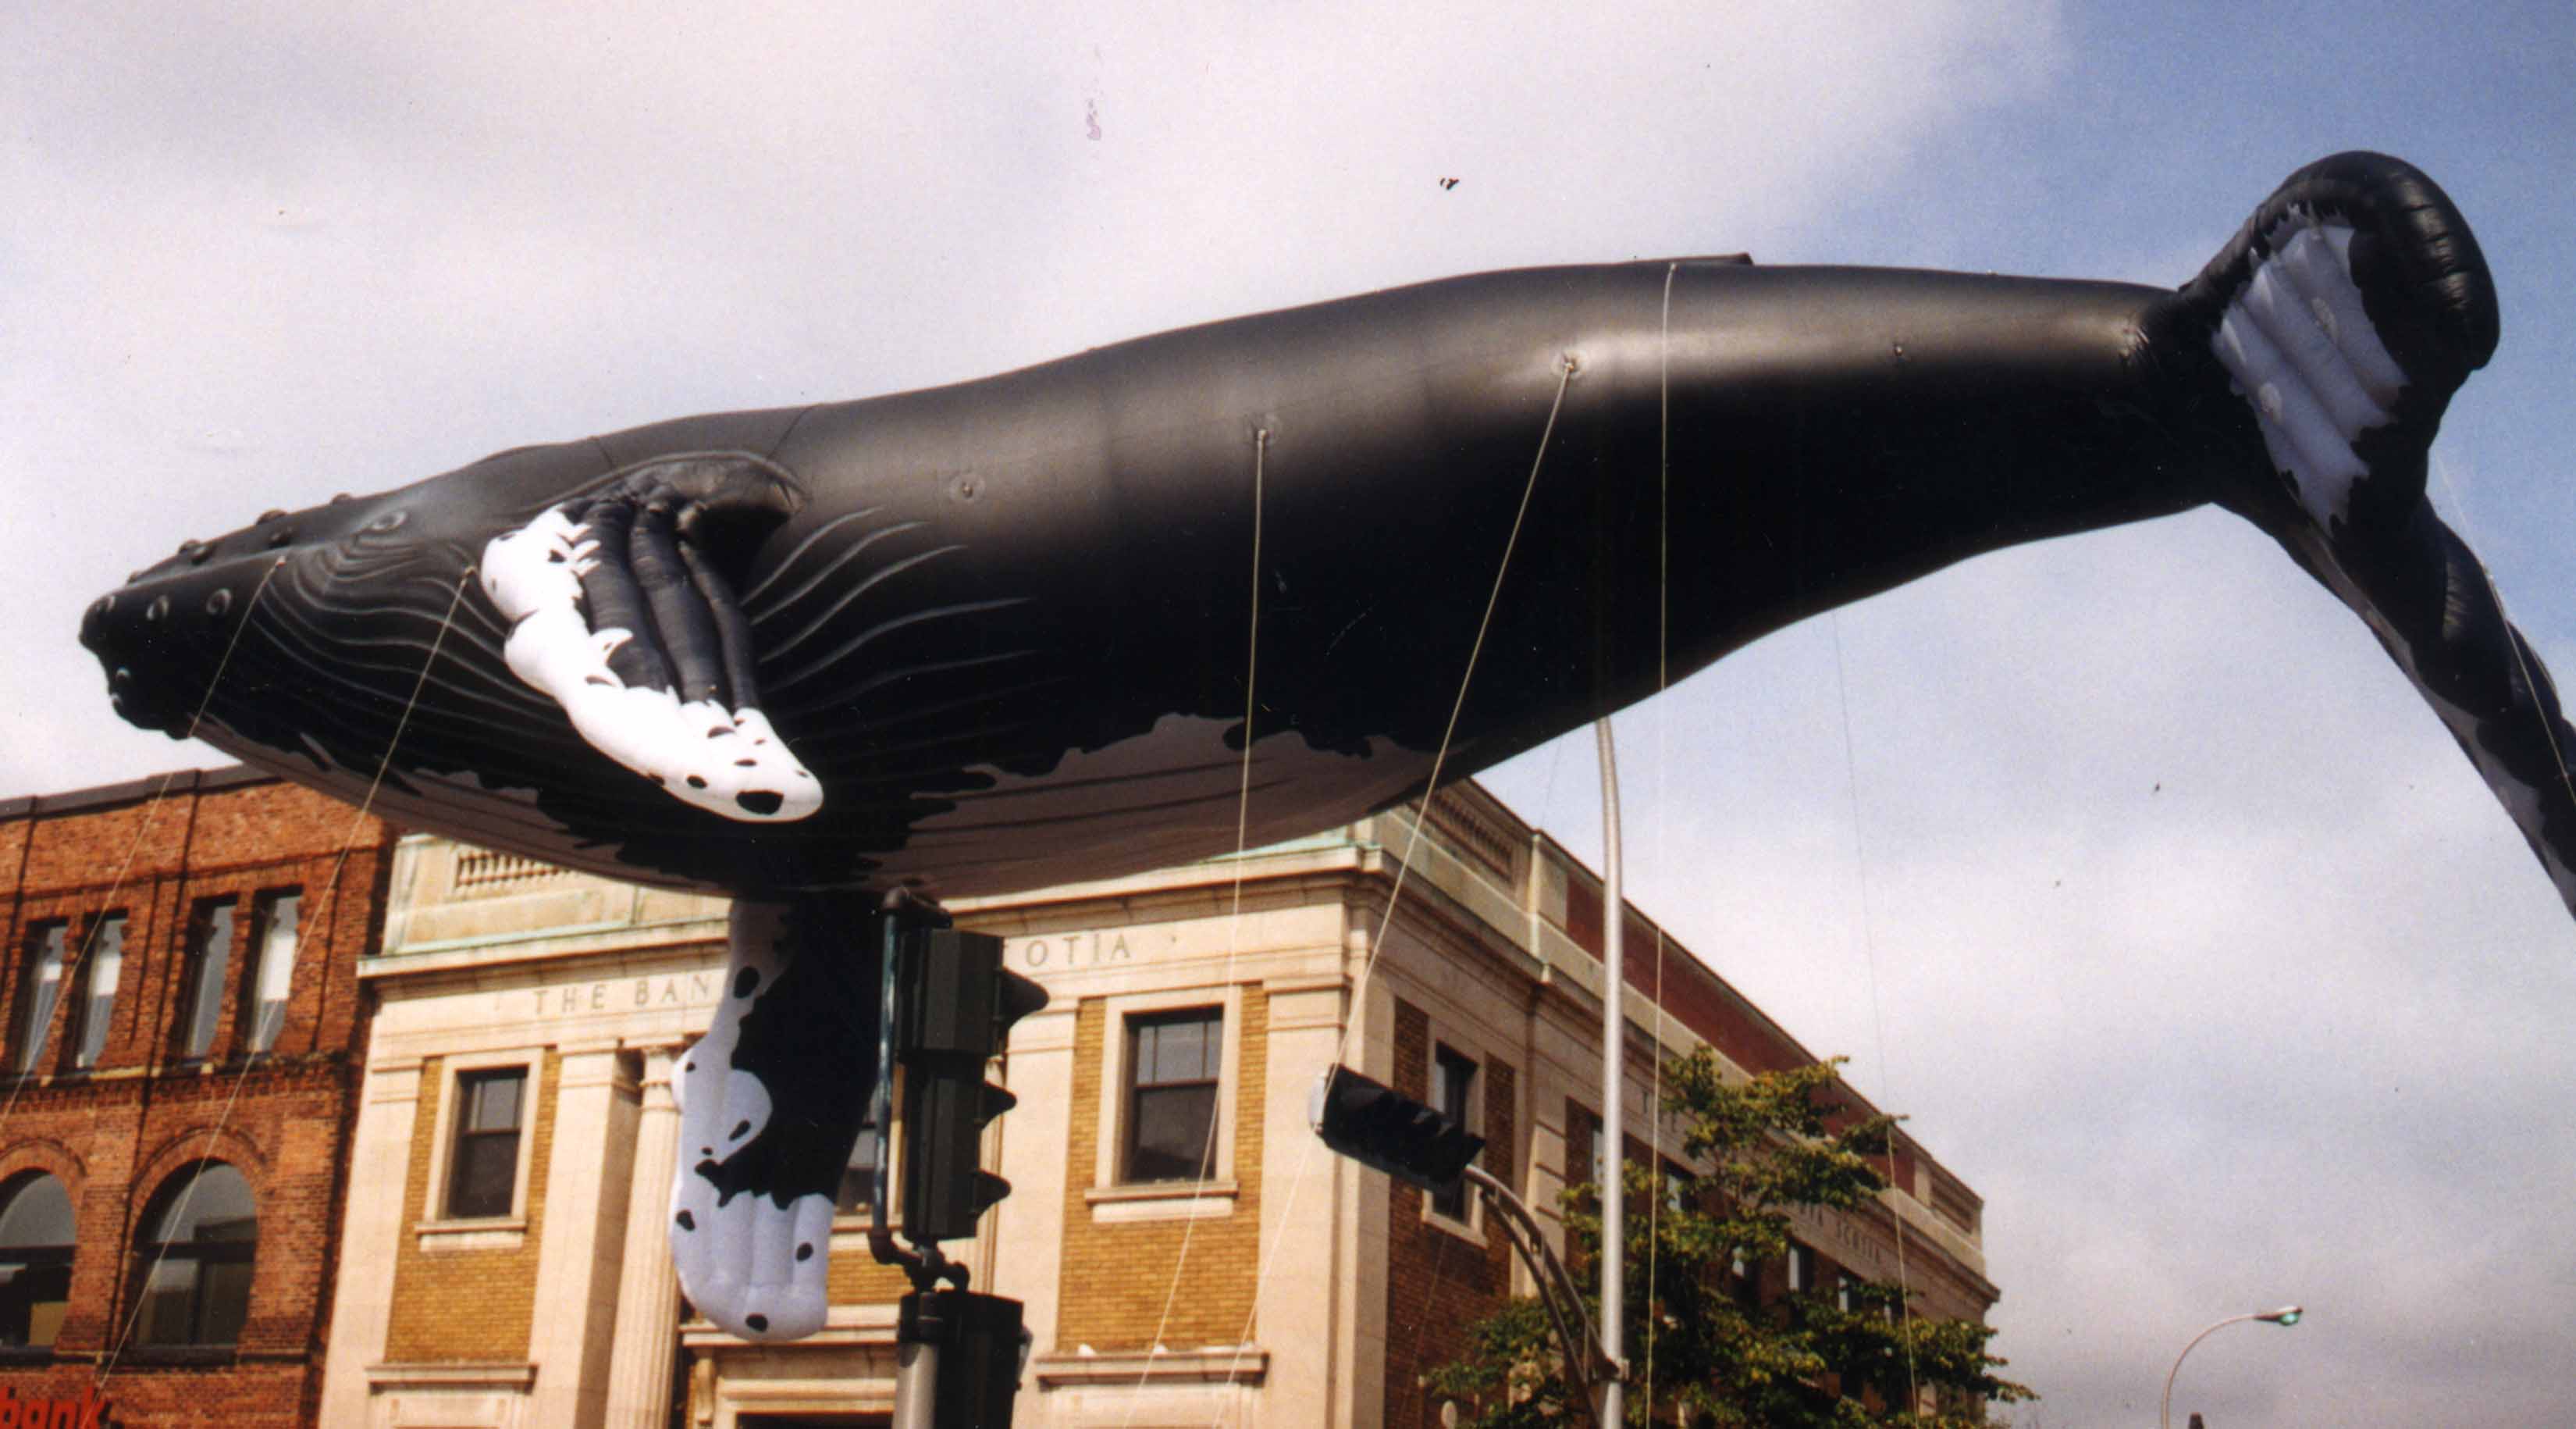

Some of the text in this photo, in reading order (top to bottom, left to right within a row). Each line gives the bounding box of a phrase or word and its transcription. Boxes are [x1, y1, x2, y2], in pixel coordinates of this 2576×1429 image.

[534, 932, 1131, 1013] THE BAN OTIA
[0, 1387, 111, 1429] bank
